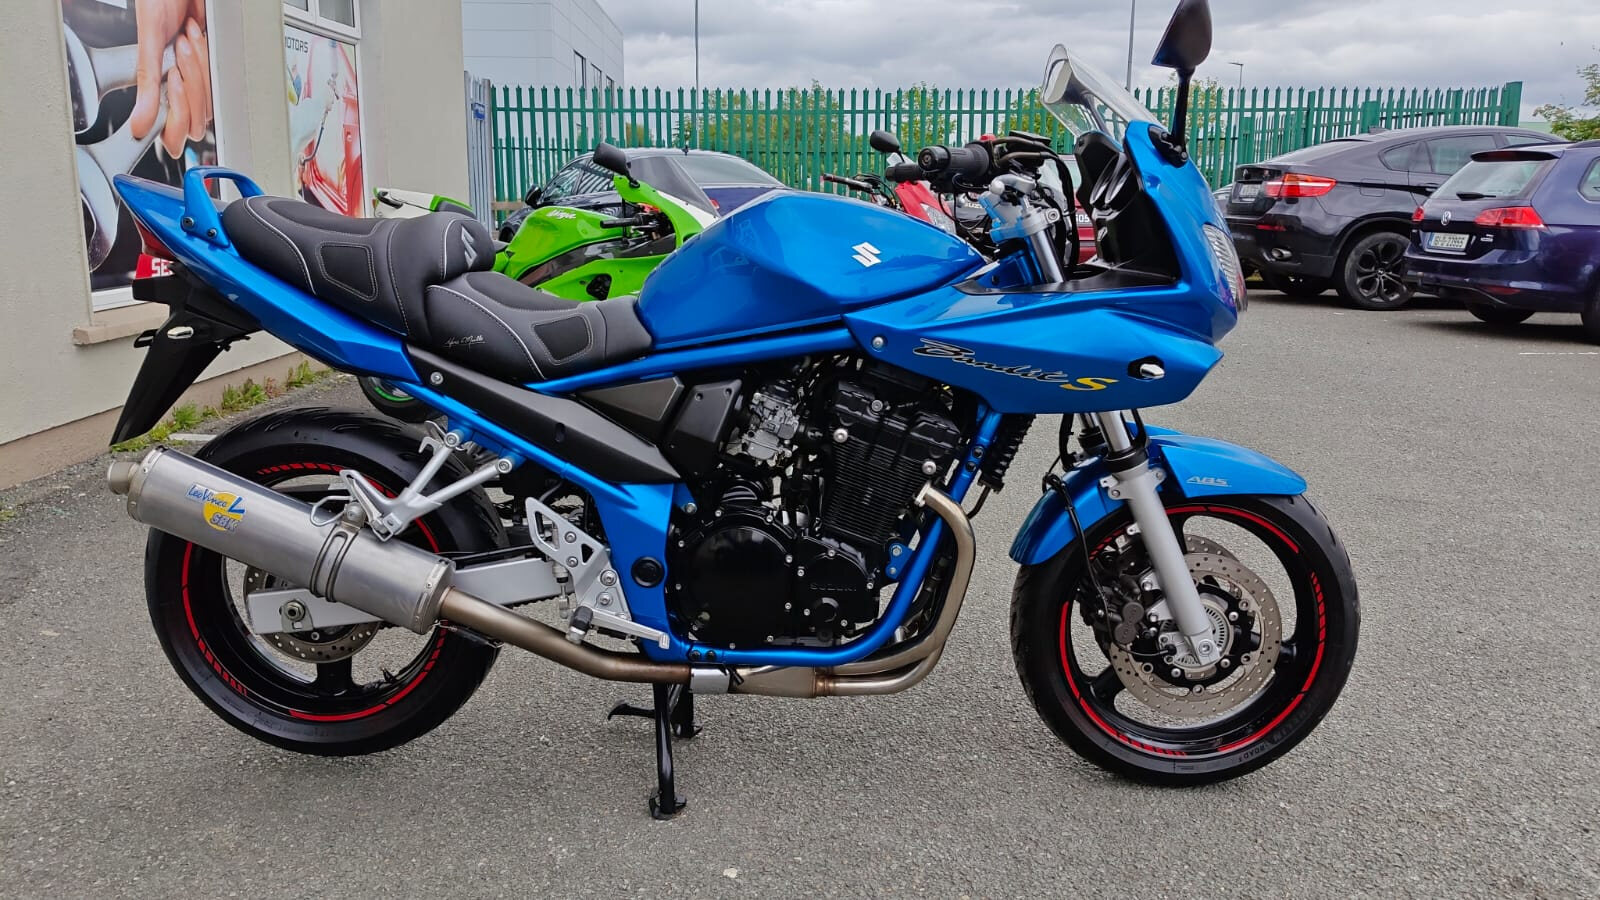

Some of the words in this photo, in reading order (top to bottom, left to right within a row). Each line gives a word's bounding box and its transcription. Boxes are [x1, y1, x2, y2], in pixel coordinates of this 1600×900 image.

[285, 37, 308, 53] OTORS
[913, 337, 1069, 383] Bandit
[1059, 376, 1120, 391] S
[1186, 475, 1231, 487] ABS
